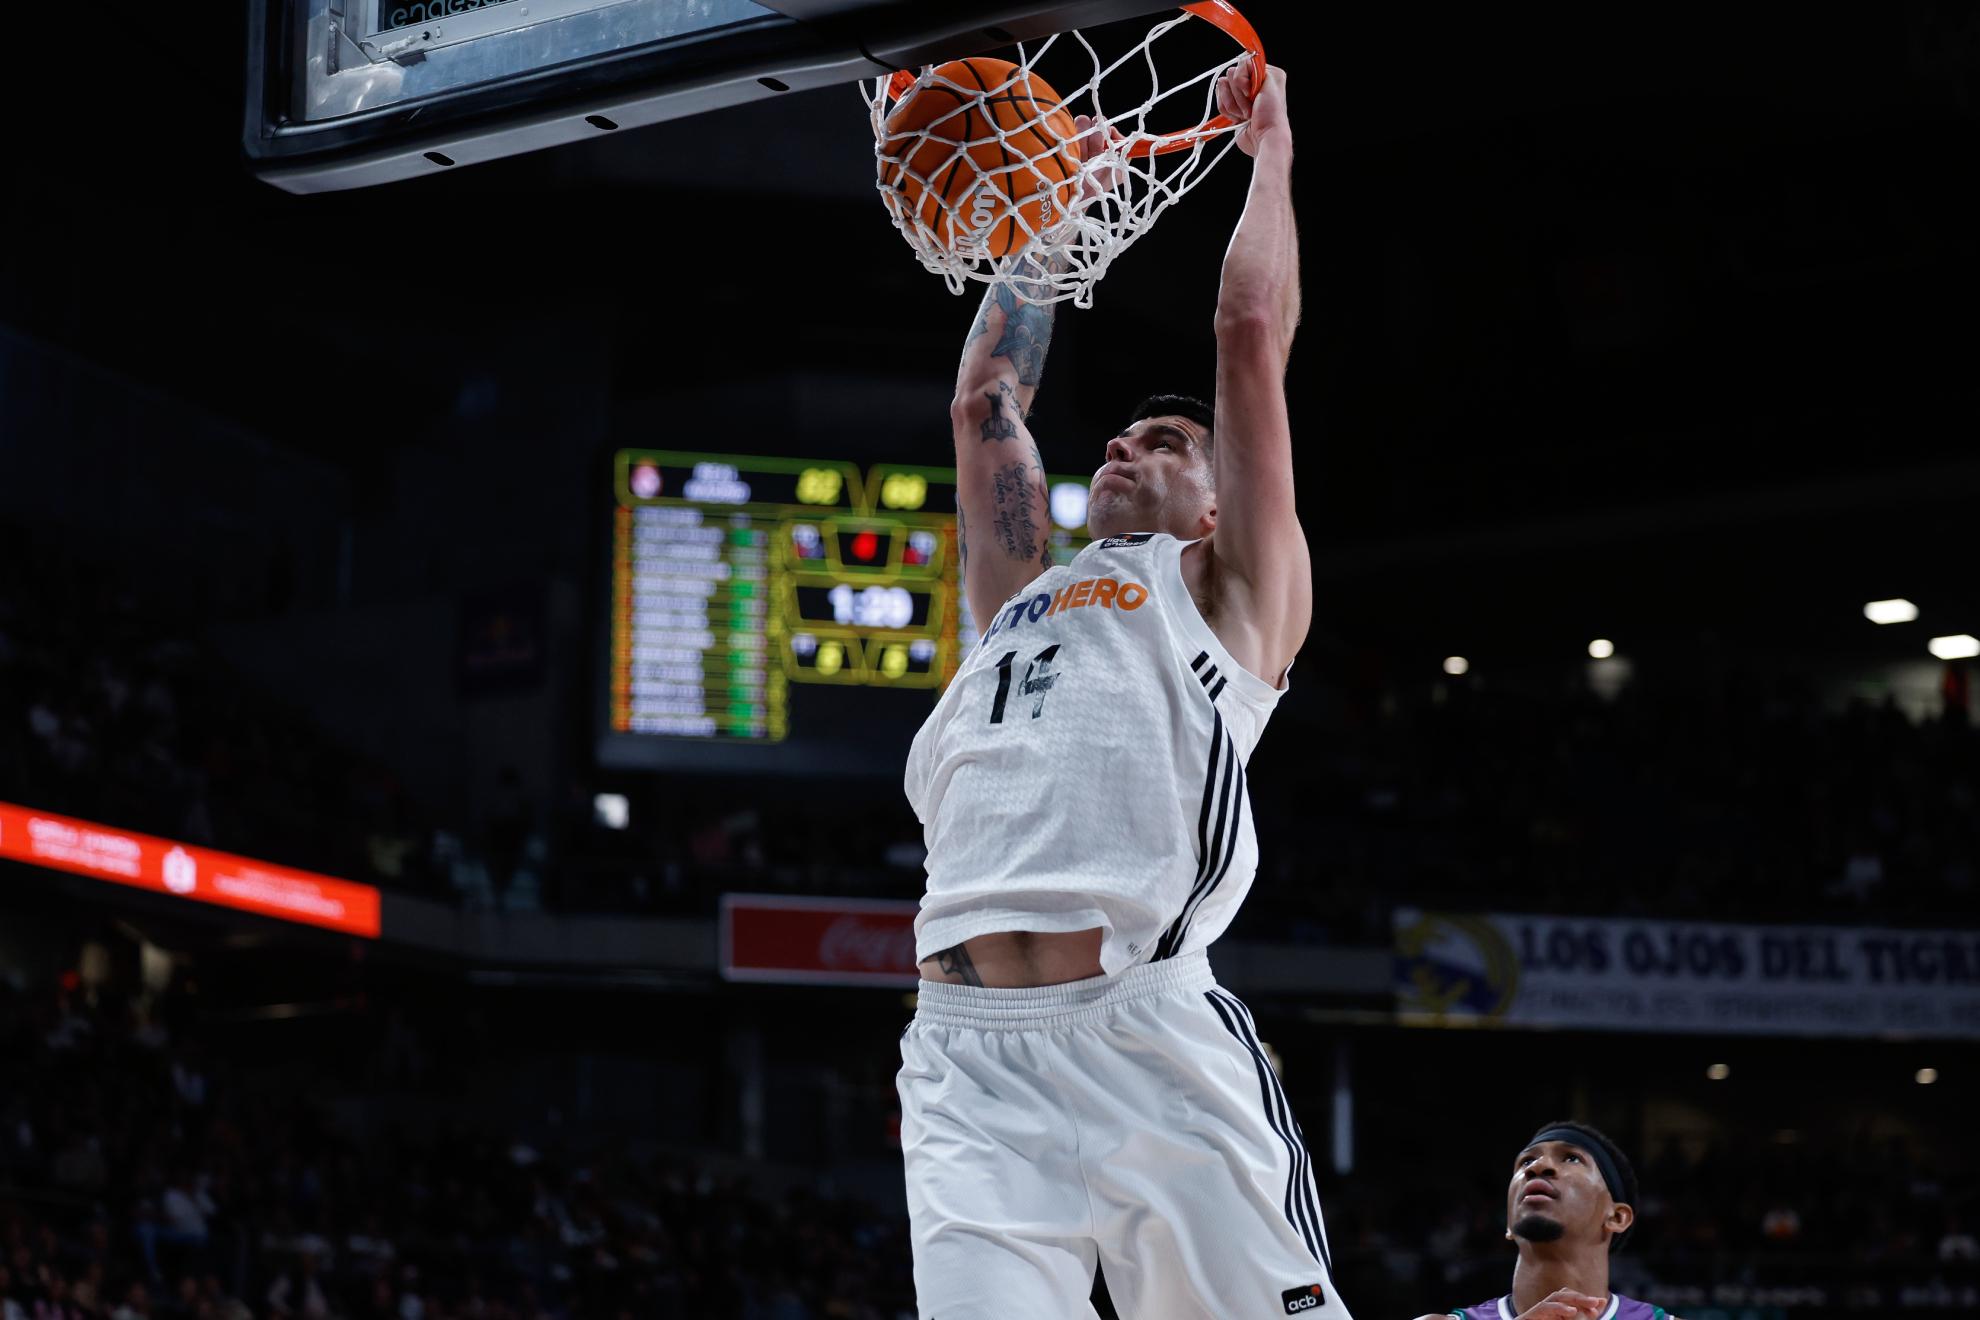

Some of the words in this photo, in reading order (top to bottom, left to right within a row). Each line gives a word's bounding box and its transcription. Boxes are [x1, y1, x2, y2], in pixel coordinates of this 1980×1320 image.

[989, 643, 1062, 724] 14
[1520, 925, 1607, 973] LOS
[1624, 930, 1745, 978] OJOS
[1760, 933, 1849, 981] DEL
[1861, 938, 1980, 984] TIGR
[1288, 1294, 1317, 1311] acb
